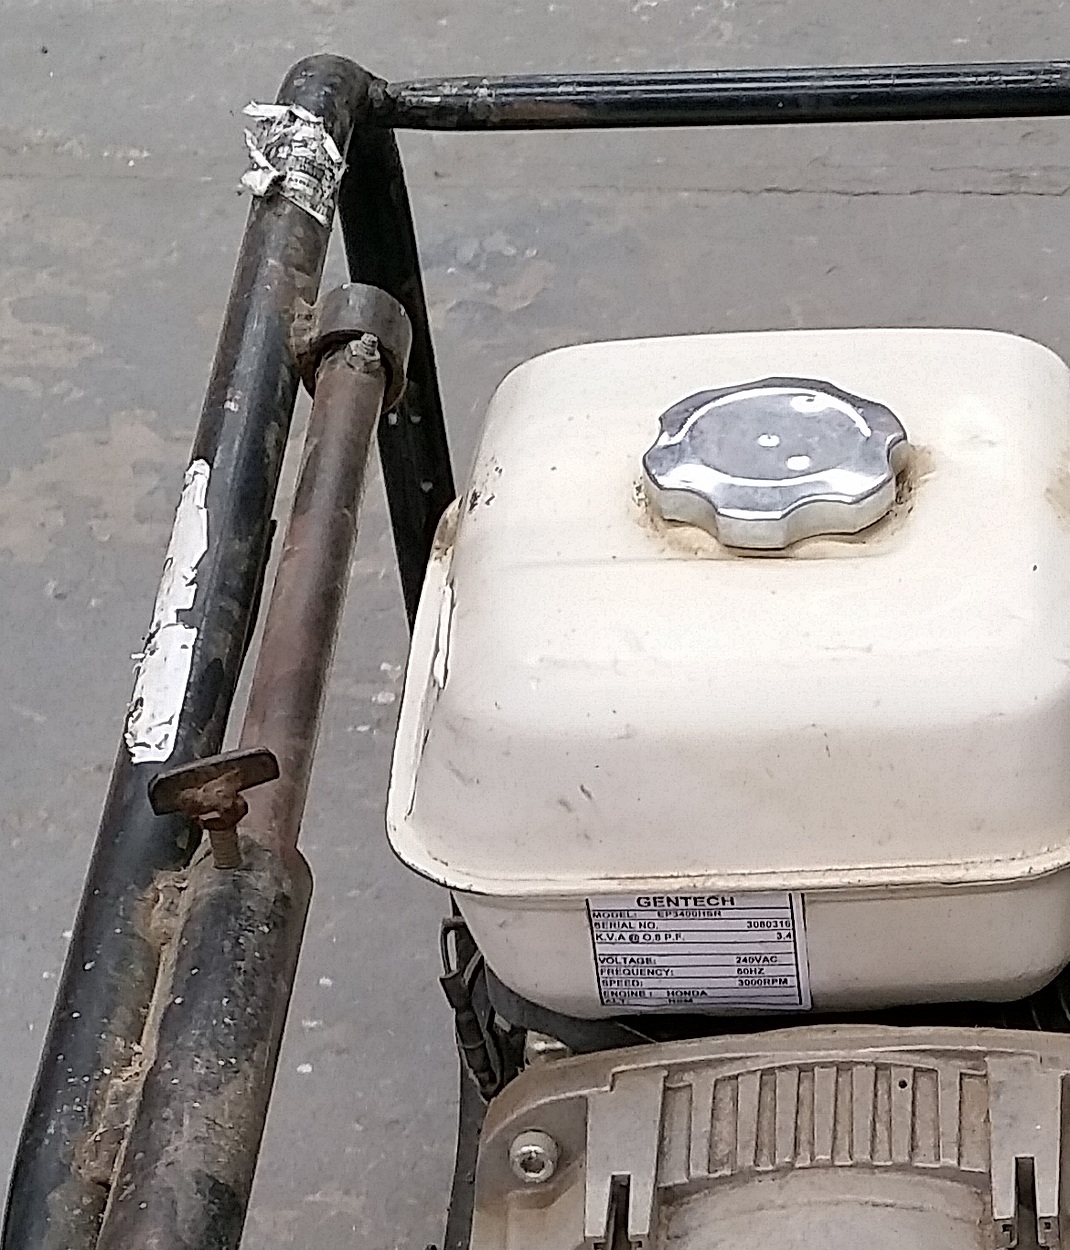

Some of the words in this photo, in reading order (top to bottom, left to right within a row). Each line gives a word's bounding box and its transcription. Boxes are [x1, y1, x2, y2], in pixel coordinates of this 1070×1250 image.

[636, 895, 735, 908] GENTECH
[594, 922, 636, 930] SERIAL
[776, 931, 792, 940] 3.4
[598, 956, 657, 965] VOLTAGE:
[735, 955, 778, 964] 240VAC
[600, 968, 674, 977] FREQUENCY:
[602, 979, 643, 987] SPEED:
[738, 978, 789, 987] 3000RPM
[667, 990, 708, 998] HONDA
